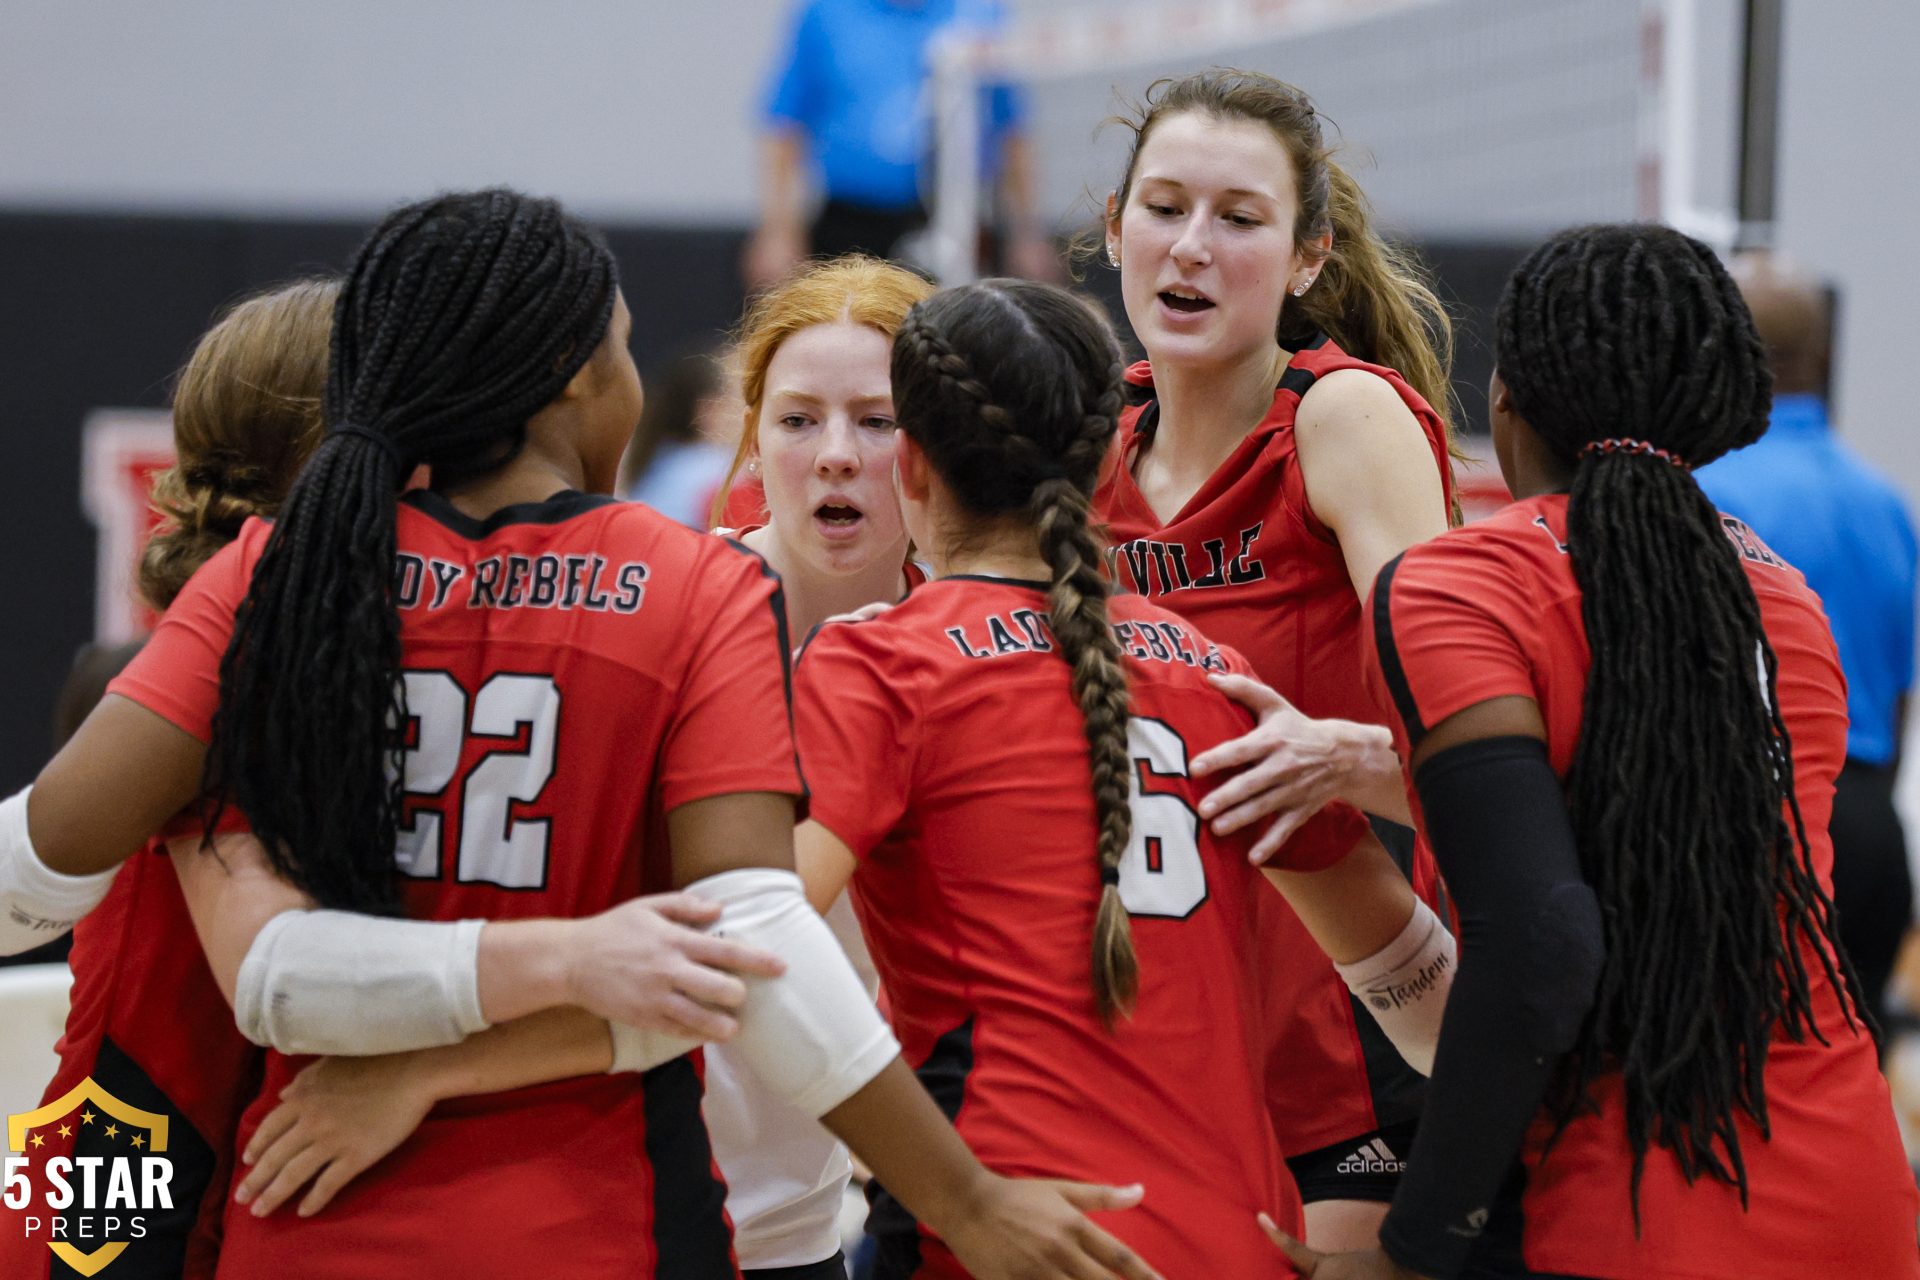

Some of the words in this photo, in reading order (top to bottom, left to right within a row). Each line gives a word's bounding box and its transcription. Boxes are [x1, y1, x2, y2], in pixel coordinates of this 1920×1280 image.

[467, 552, 649, 614] REBELS
[945, 608, 1053, 659] LAD
[384, 668, 562, 892] 22
[1117, 714, 1210, 921] 6
[1367, 952, 1450, 1010] Tandem
[1336, 1159, 1408, 1174] adidas
